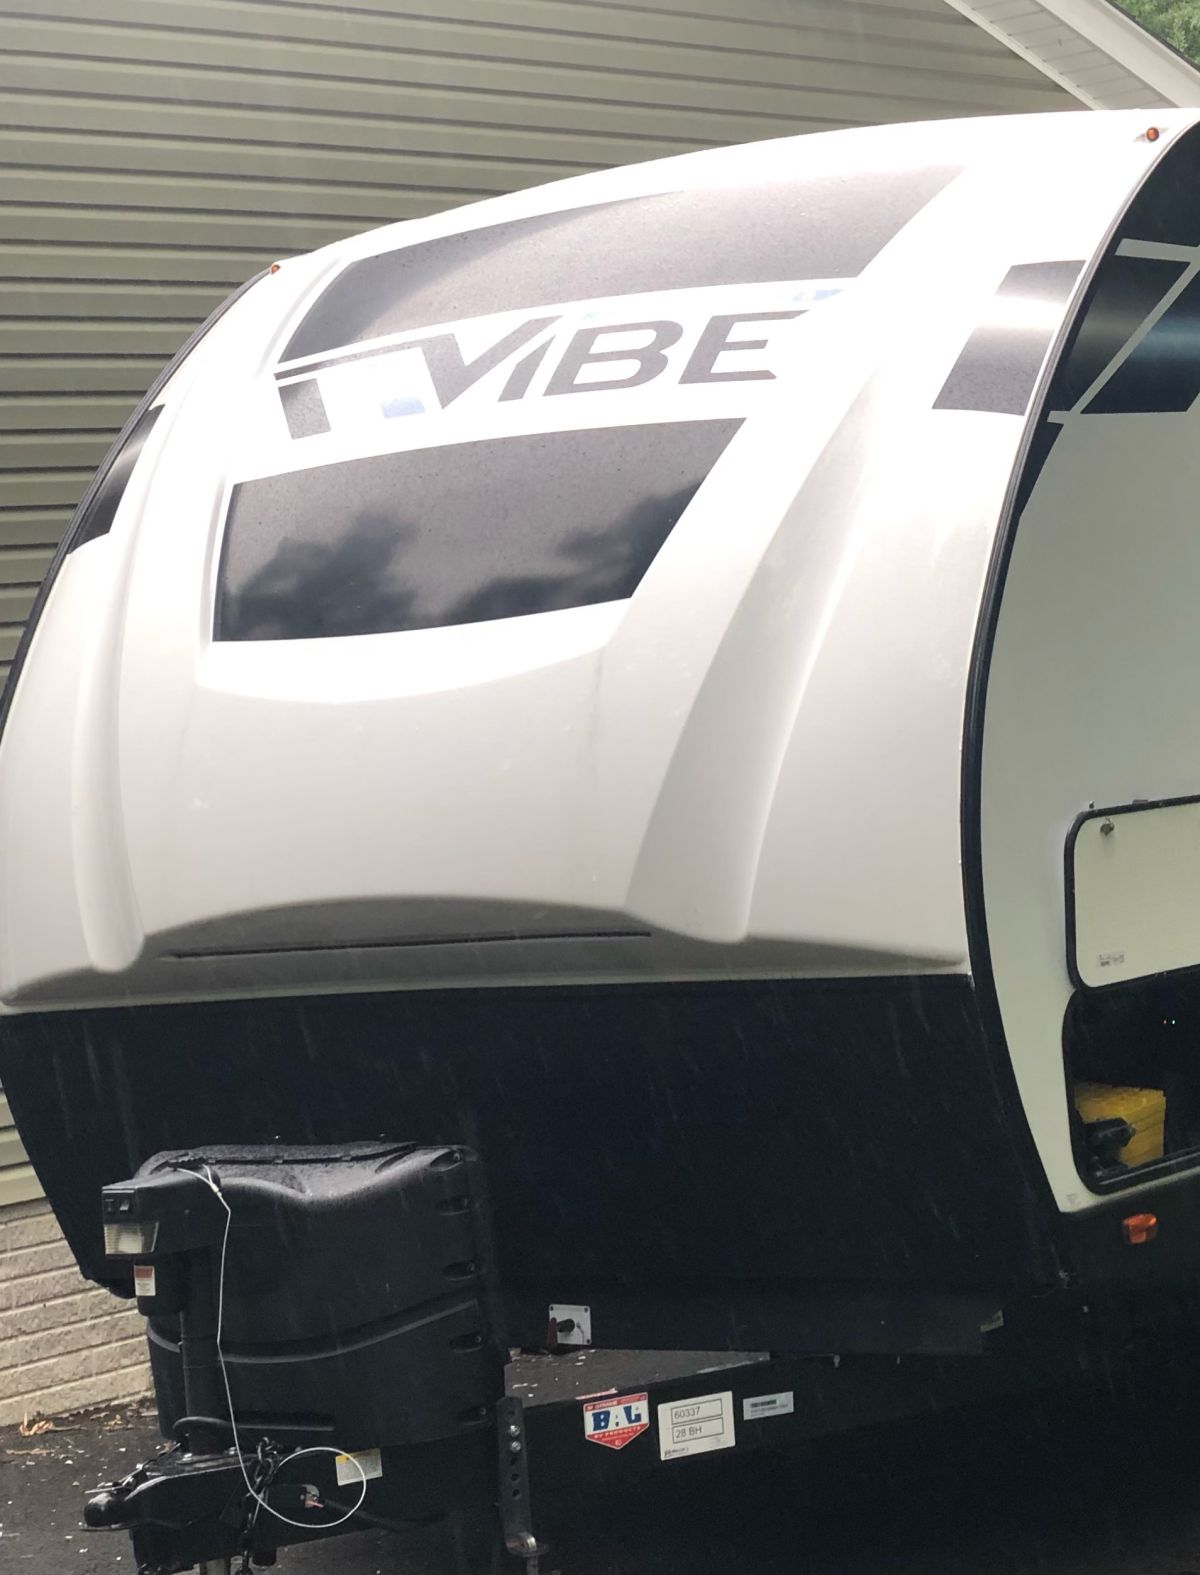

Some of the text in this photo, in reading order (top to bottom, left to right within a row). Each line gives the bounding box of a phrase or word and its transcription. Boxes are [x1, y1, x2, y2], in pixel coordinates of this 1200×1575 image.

[330, 309, 809, 410] VIBE
[673, 1406, 701, 1419] 60337
[675, 1426, 702, 1439] 28 BH
